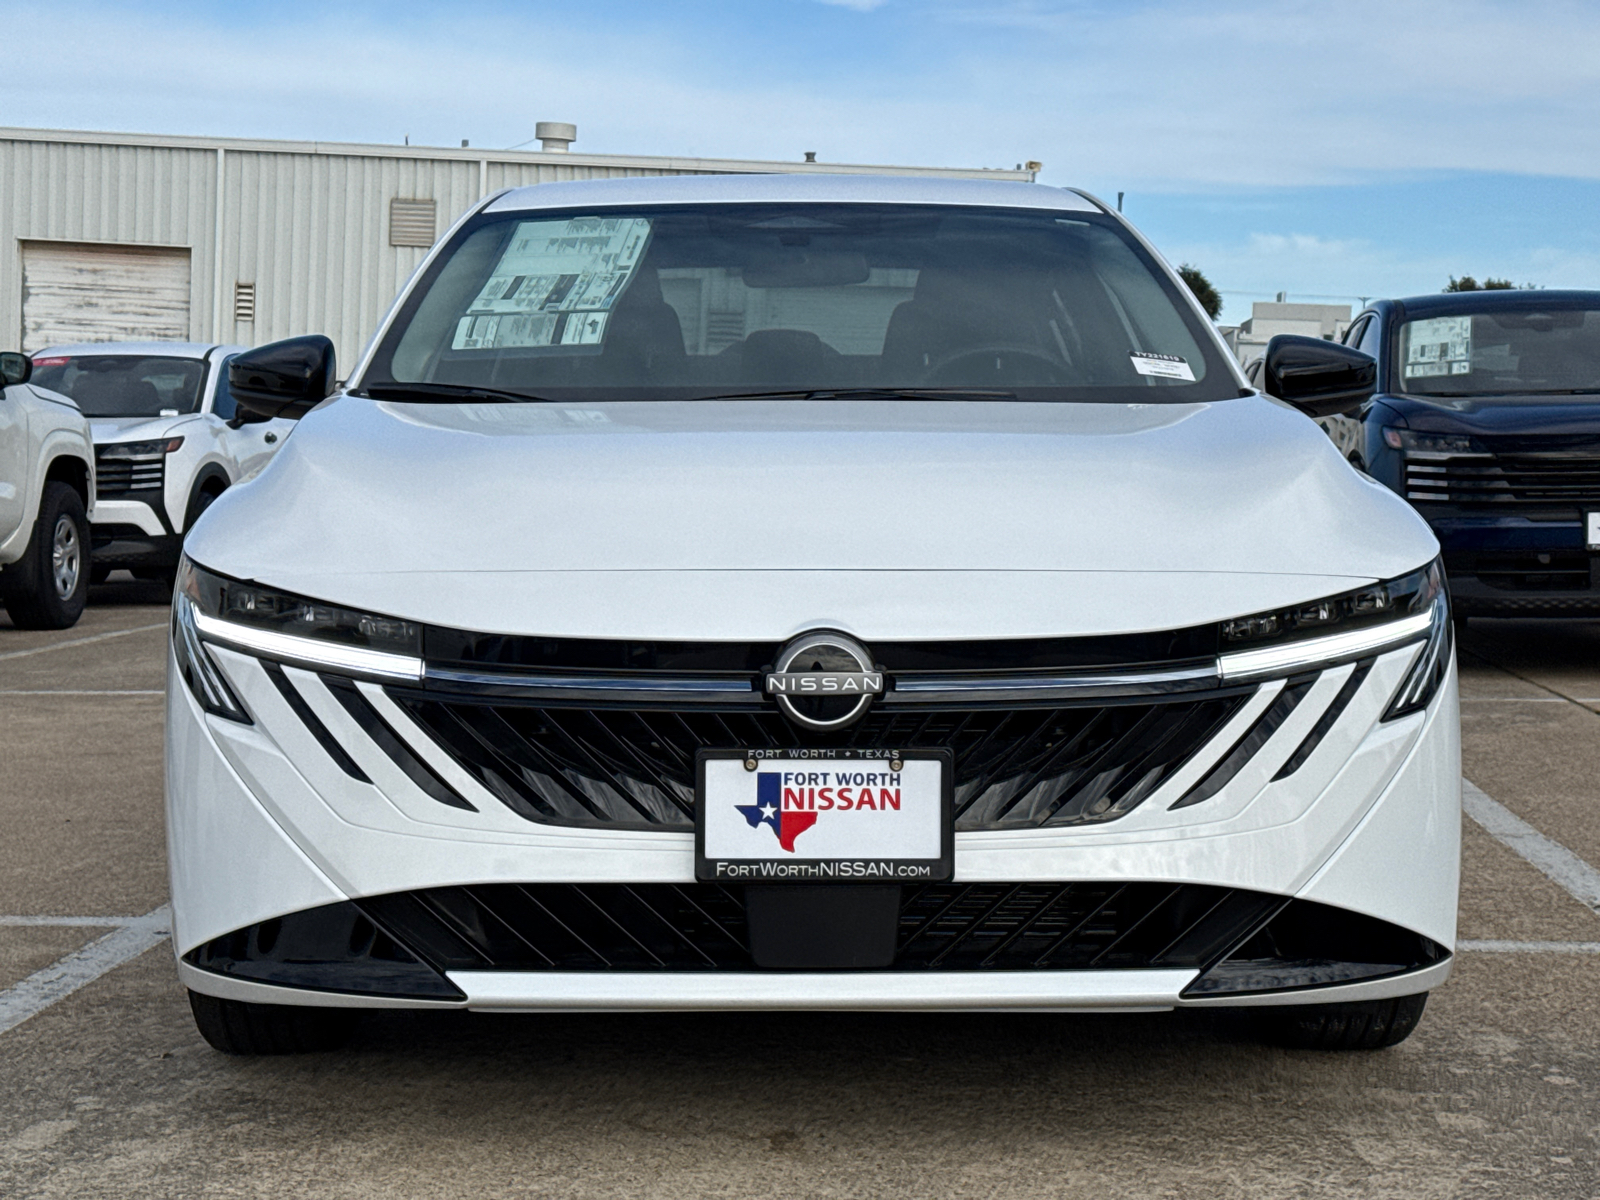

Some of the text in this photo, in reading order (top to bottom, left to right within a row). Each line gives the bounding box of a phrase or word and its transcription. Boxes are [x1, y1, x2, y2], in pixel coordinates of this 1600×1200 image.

[769, 677, 880, 691] NISSAN
[748, 750, 900, 758] FORT WORTH TEXAS
[784, 772, 901, 786] FORT WORTH
[784, 787, 901, 811] NISSAN
